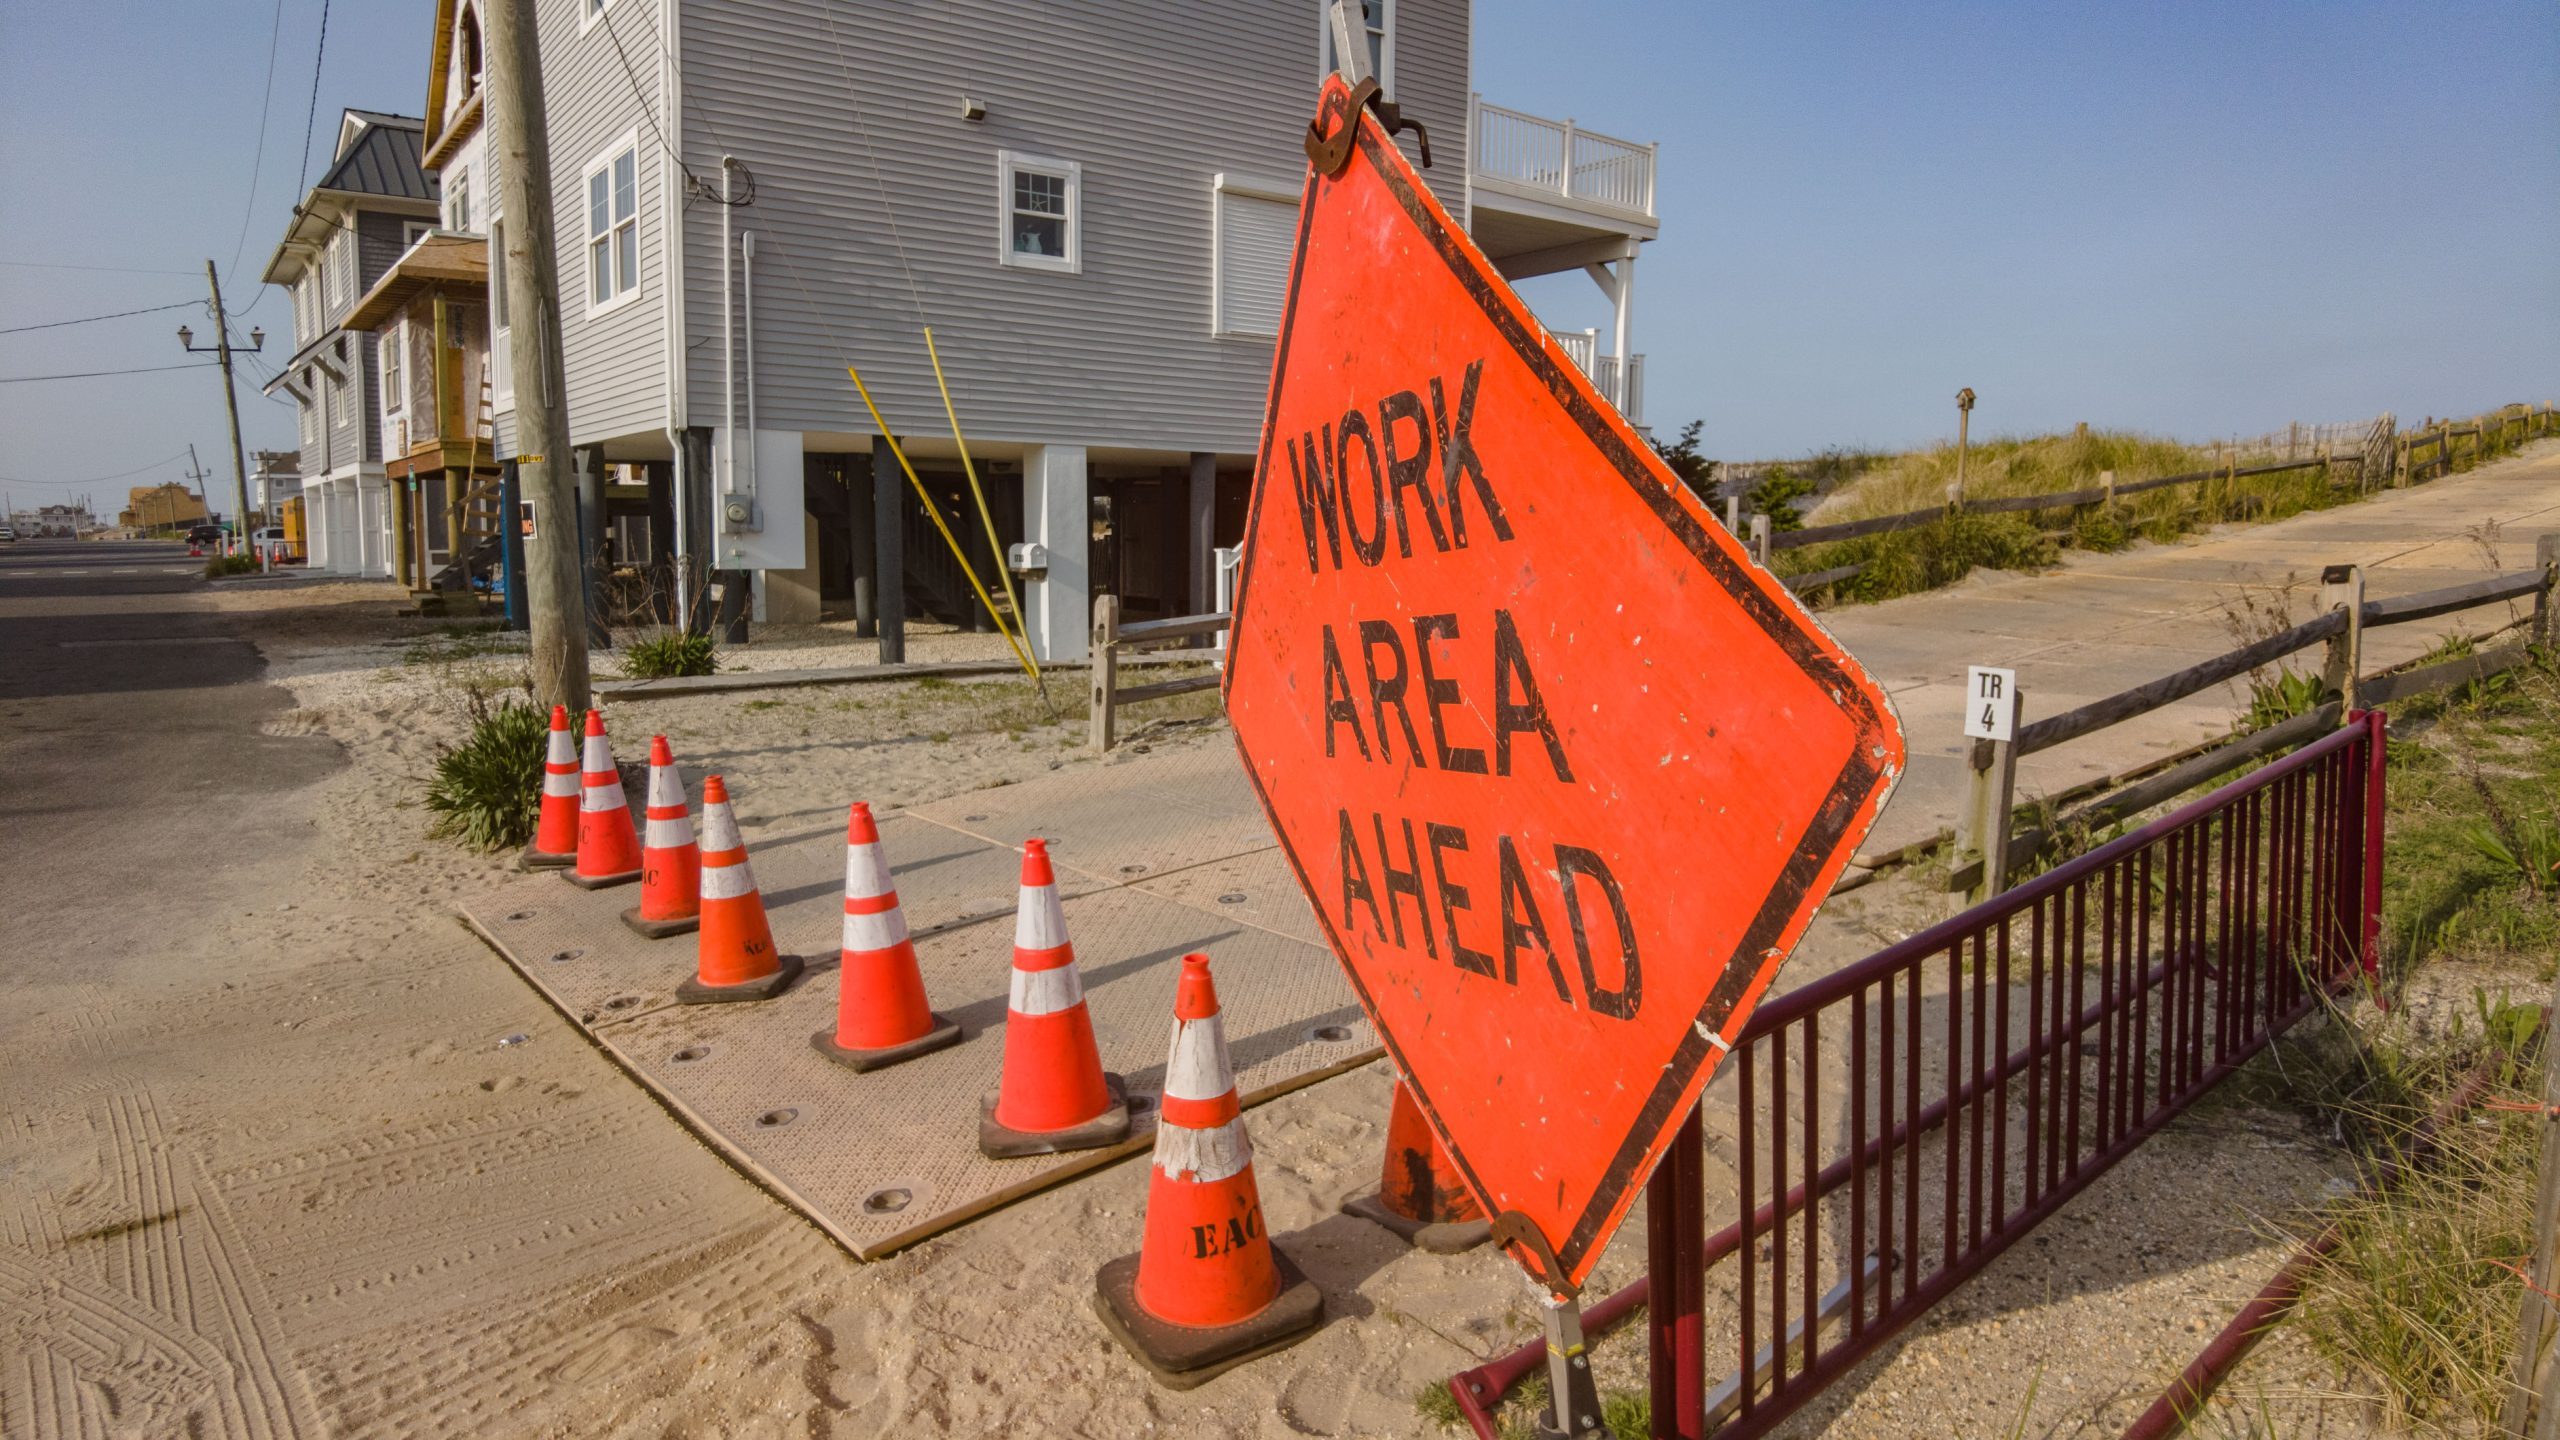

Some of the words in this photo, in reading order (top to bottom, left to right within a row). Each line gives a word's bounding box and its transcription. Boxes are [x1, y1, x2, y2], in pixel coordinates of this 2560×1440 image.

[1286, 358, 1514, 574] WORK
[1322, 609, 1576, 784] AREA
[1978, 672, 2003, 699] TR
[1981, 703, 1995, 732] 4
[1339, 808, 1643, 1021] AHEAD
